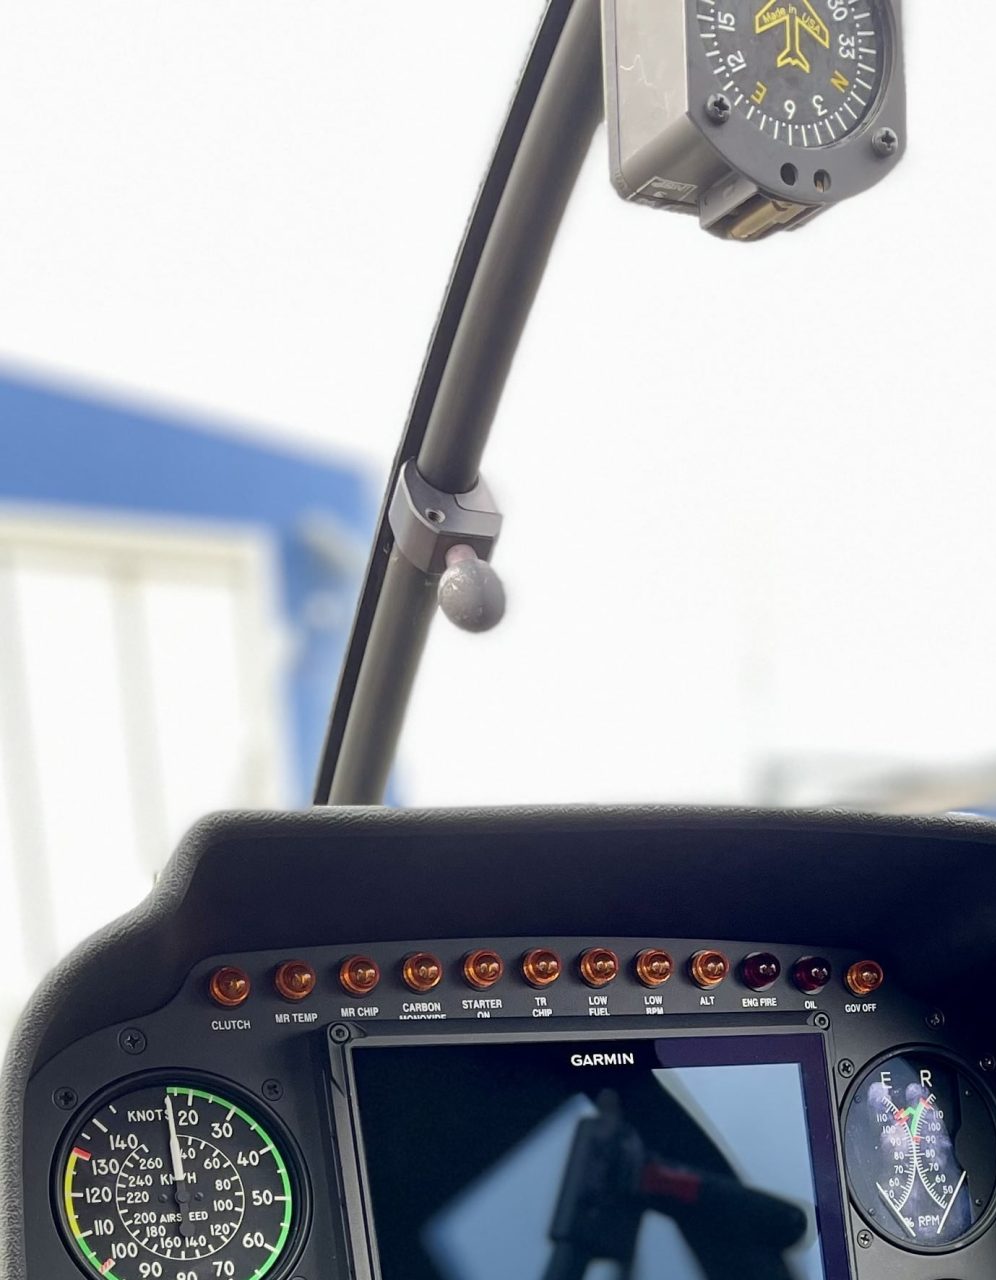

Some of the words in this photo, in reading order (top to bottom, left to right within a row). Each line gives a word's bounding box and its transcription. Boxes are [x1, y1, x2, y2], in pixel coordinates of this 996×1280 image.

[762, 7, 786, 24] Made
[788, 3, 797, 14] in
[802, 14, 821, 34] USA
[462, 1000, 502, 1009] STARTER
[535, 997, 547, 1006] TR
[589, 996, 607, 1005] LOW
[644, 996, 662, 1005] LOW
[700, 996, 715, 1005] ALT
[742, 998, 759, 1008] ENG
[760, 998, 778, 1007] FIRE
[805, 1001, 817, 1009] OIL
[341, 1007, 355, 1017] MR
[357, 1007, 379, 1017] CHIP
[402, 1003, 441, 1012] CARBON
[532, 1008, 552, 1017] CHIP
[589, 1008, 610, 1016] FUEL
[646, 1007, 663, 1015] RPM
[845, 1004, 860, 1013] GOV
[862, 1003, 876, 1012] OFF
[276, 1014, 290, 1023] MR
[292, 1013, 317, 1022] TEMP
[212, 1020, 251, 1031] CLUTCH
[571, 1053, 634, 1066] GARMIN
[128, 1110, 171, 1122] KNOTS
[109, 1134, 138, 1150] 140
[92, 1159, 119, 1174] 130
[86, 1187, 112, 1203] 120
[919, 1216, 940, 1226] RPM
[94, 1220, 114, 1235] 110
[112, 1243, 138, 1258] 100
